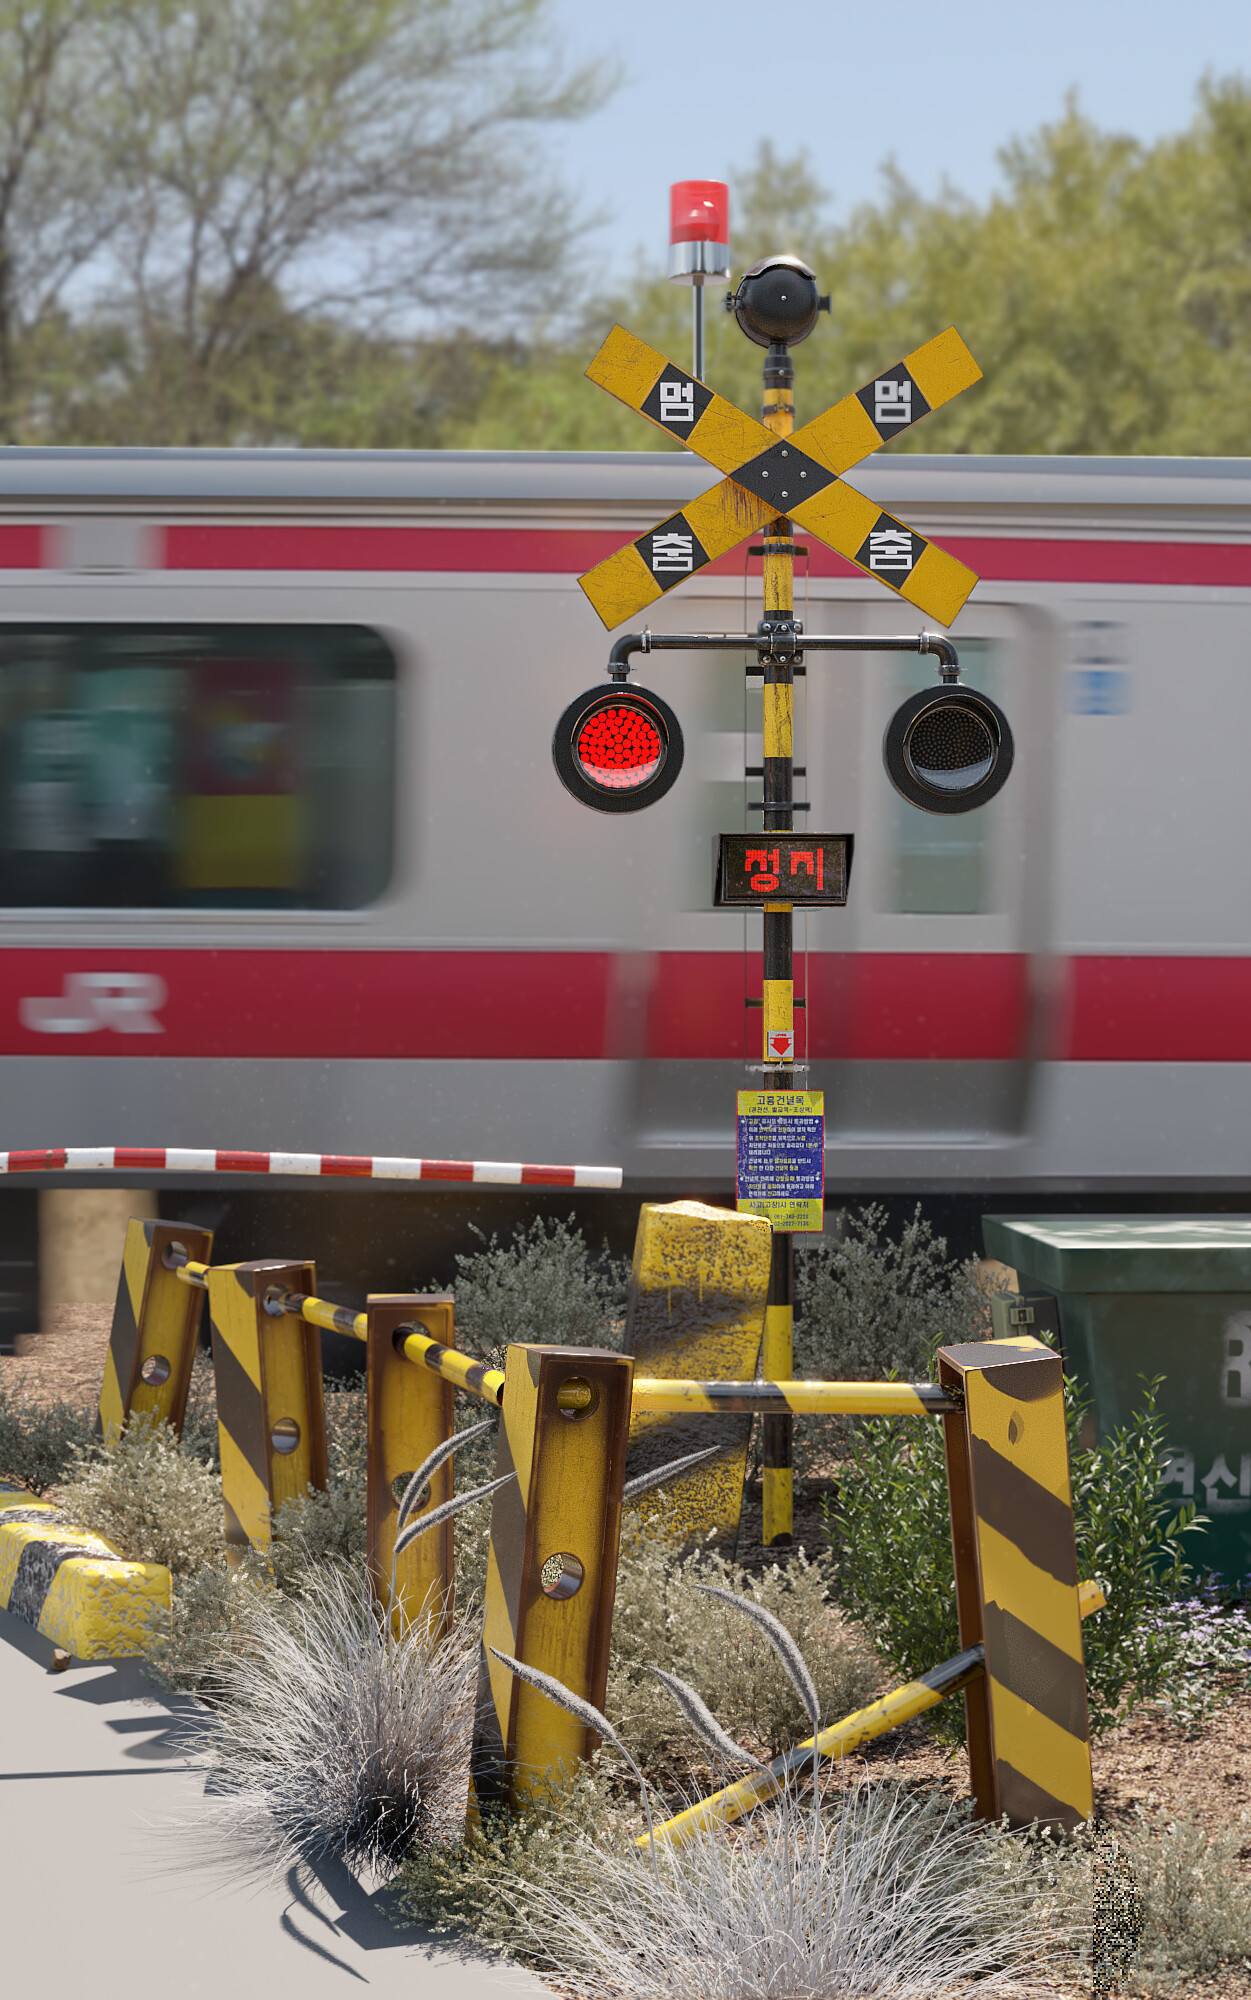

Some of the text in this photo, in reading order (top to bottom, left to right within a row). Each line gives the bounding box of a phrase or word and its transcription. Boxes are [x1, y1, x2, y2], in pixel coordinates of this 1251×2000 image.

[660, 381, 694, 422] 멈
[874, 380, 912, 424] 멈
[652, 532, 693, 572] 춤
[869, 529, 913, 570] 춤
[745, 848, 824, 893] 정지
[18, 972, 168, 1034] JR
[756, 1095, 804, 1106] 고흥건널목
